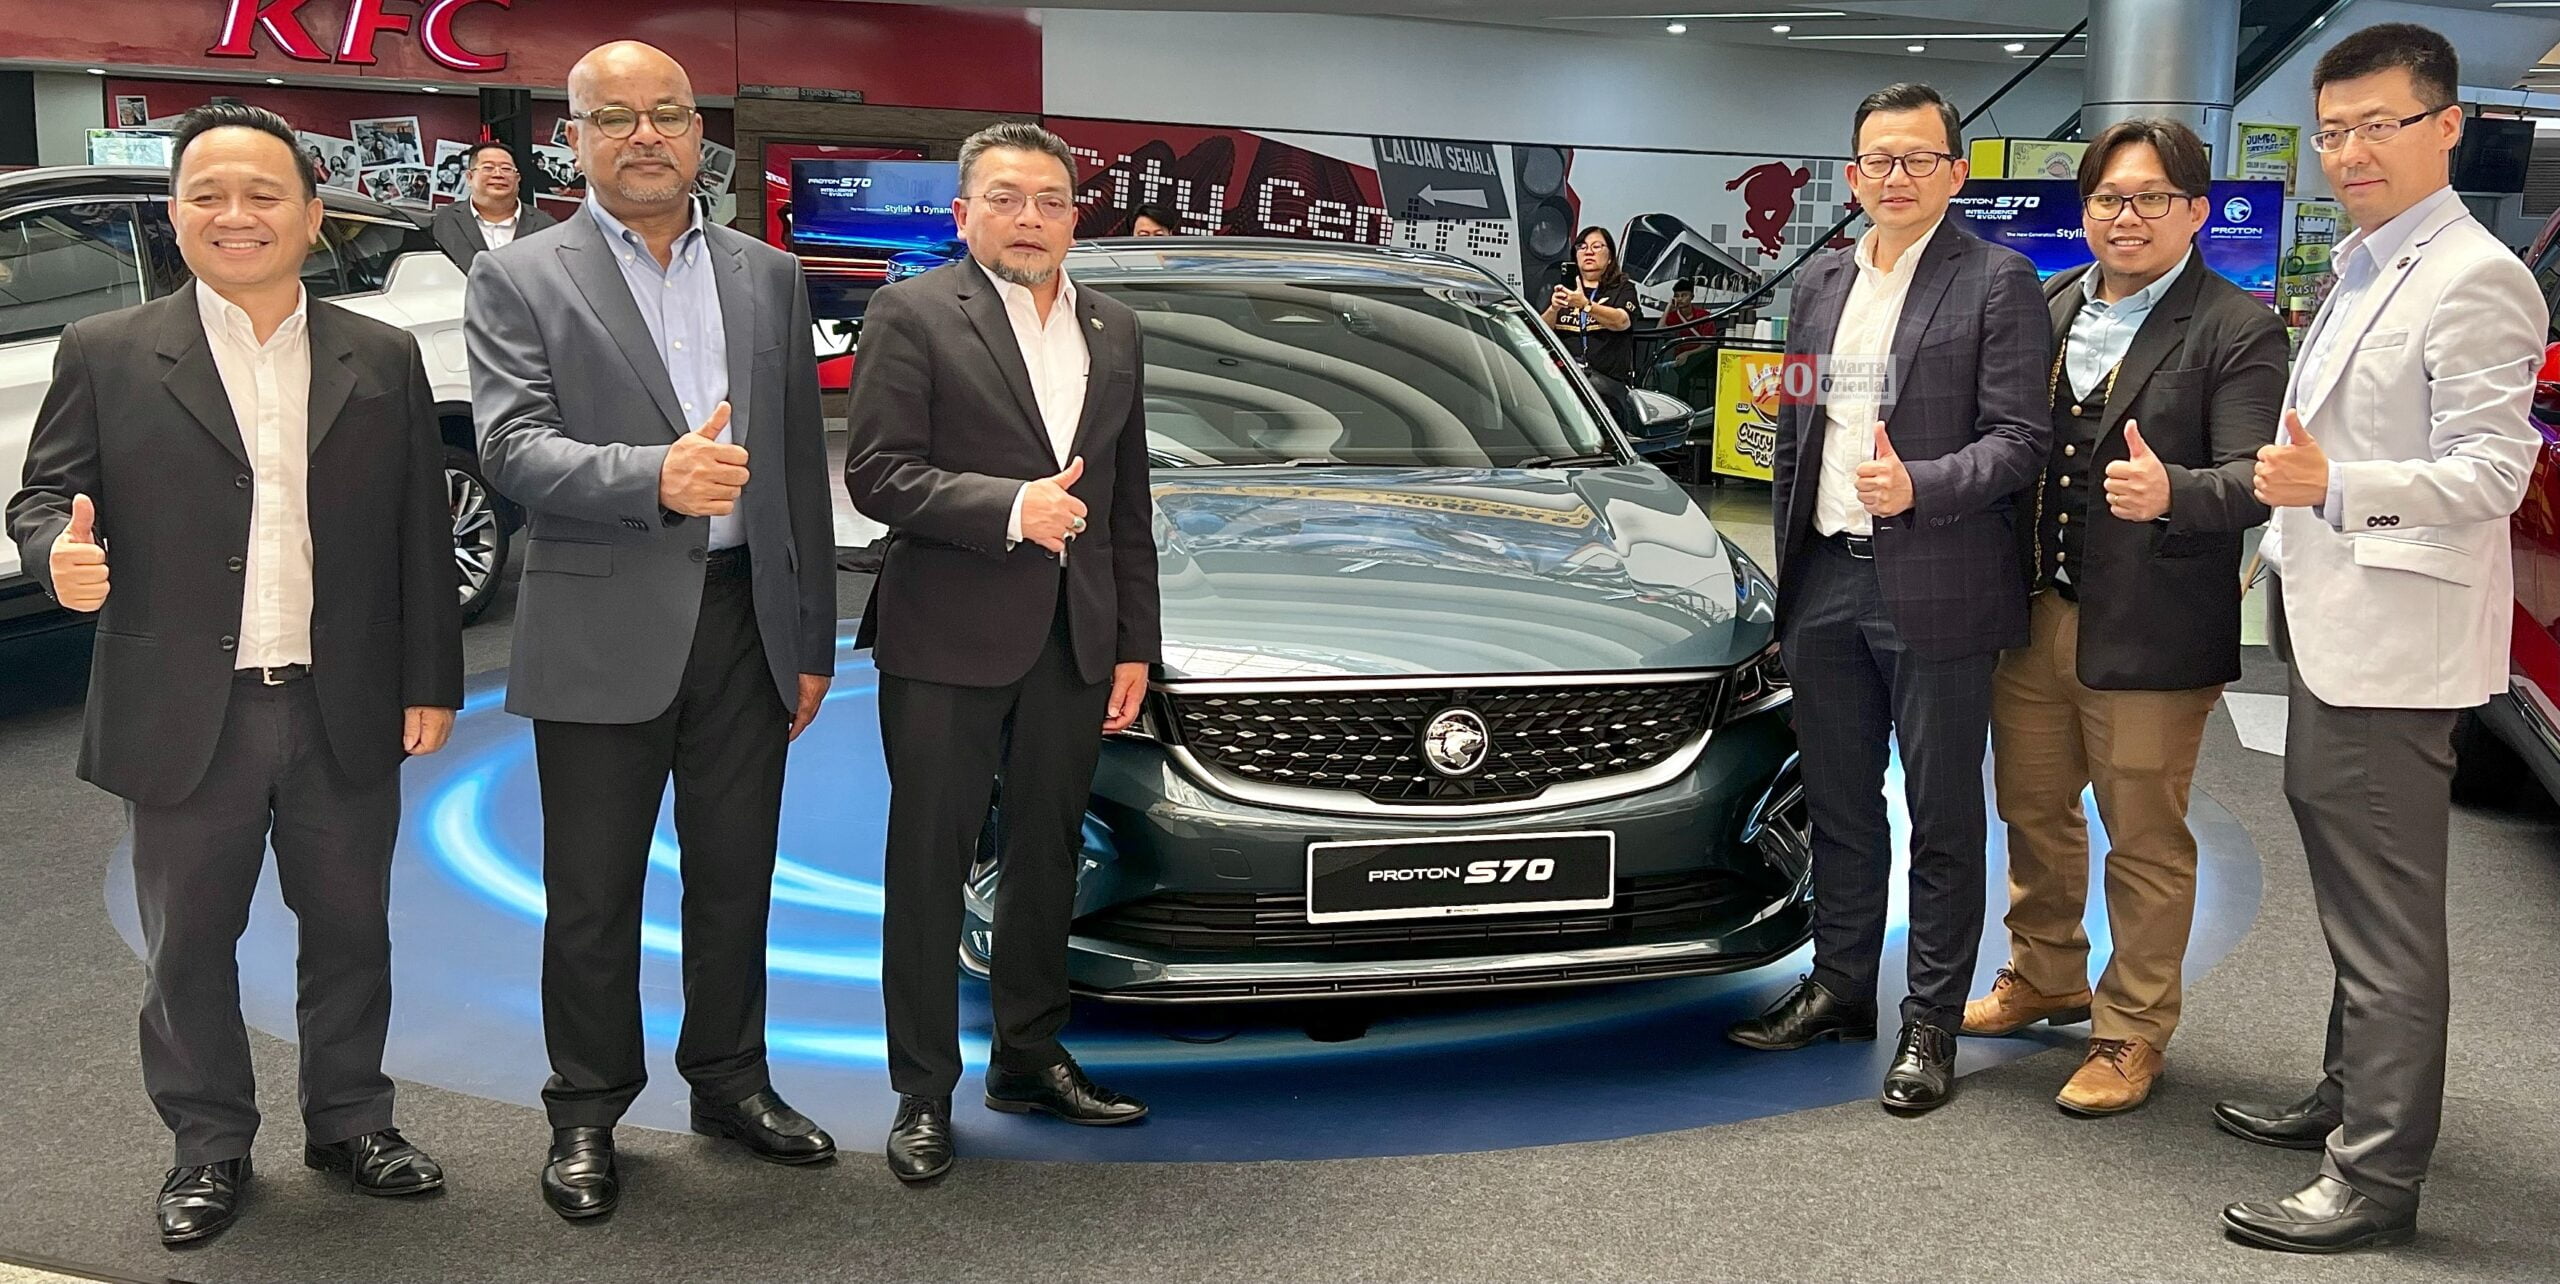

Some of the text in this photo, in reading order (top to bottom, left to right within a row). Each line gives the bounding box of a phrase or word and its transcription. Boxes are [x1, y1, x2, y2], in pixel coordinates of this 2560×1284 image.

[205, 0, 508, 73] KFC
[1379, 138, 1496, 176] LALUAN SEHALA
[840, 177, 873, 188] S70
[1994, 196, 2040, 208] S70
[884, 204, 913, 214] Stylish
[914, 205, 921, 213] &
[922, 205, 953, 215] Dynam
[2056, 228, 2087, 239] Stylis
[2210, 226, 2263, 234] PROTON
[1739, 422, 1774, 452] Curry
[1368, 858, 1555, 885] PROTON S70
